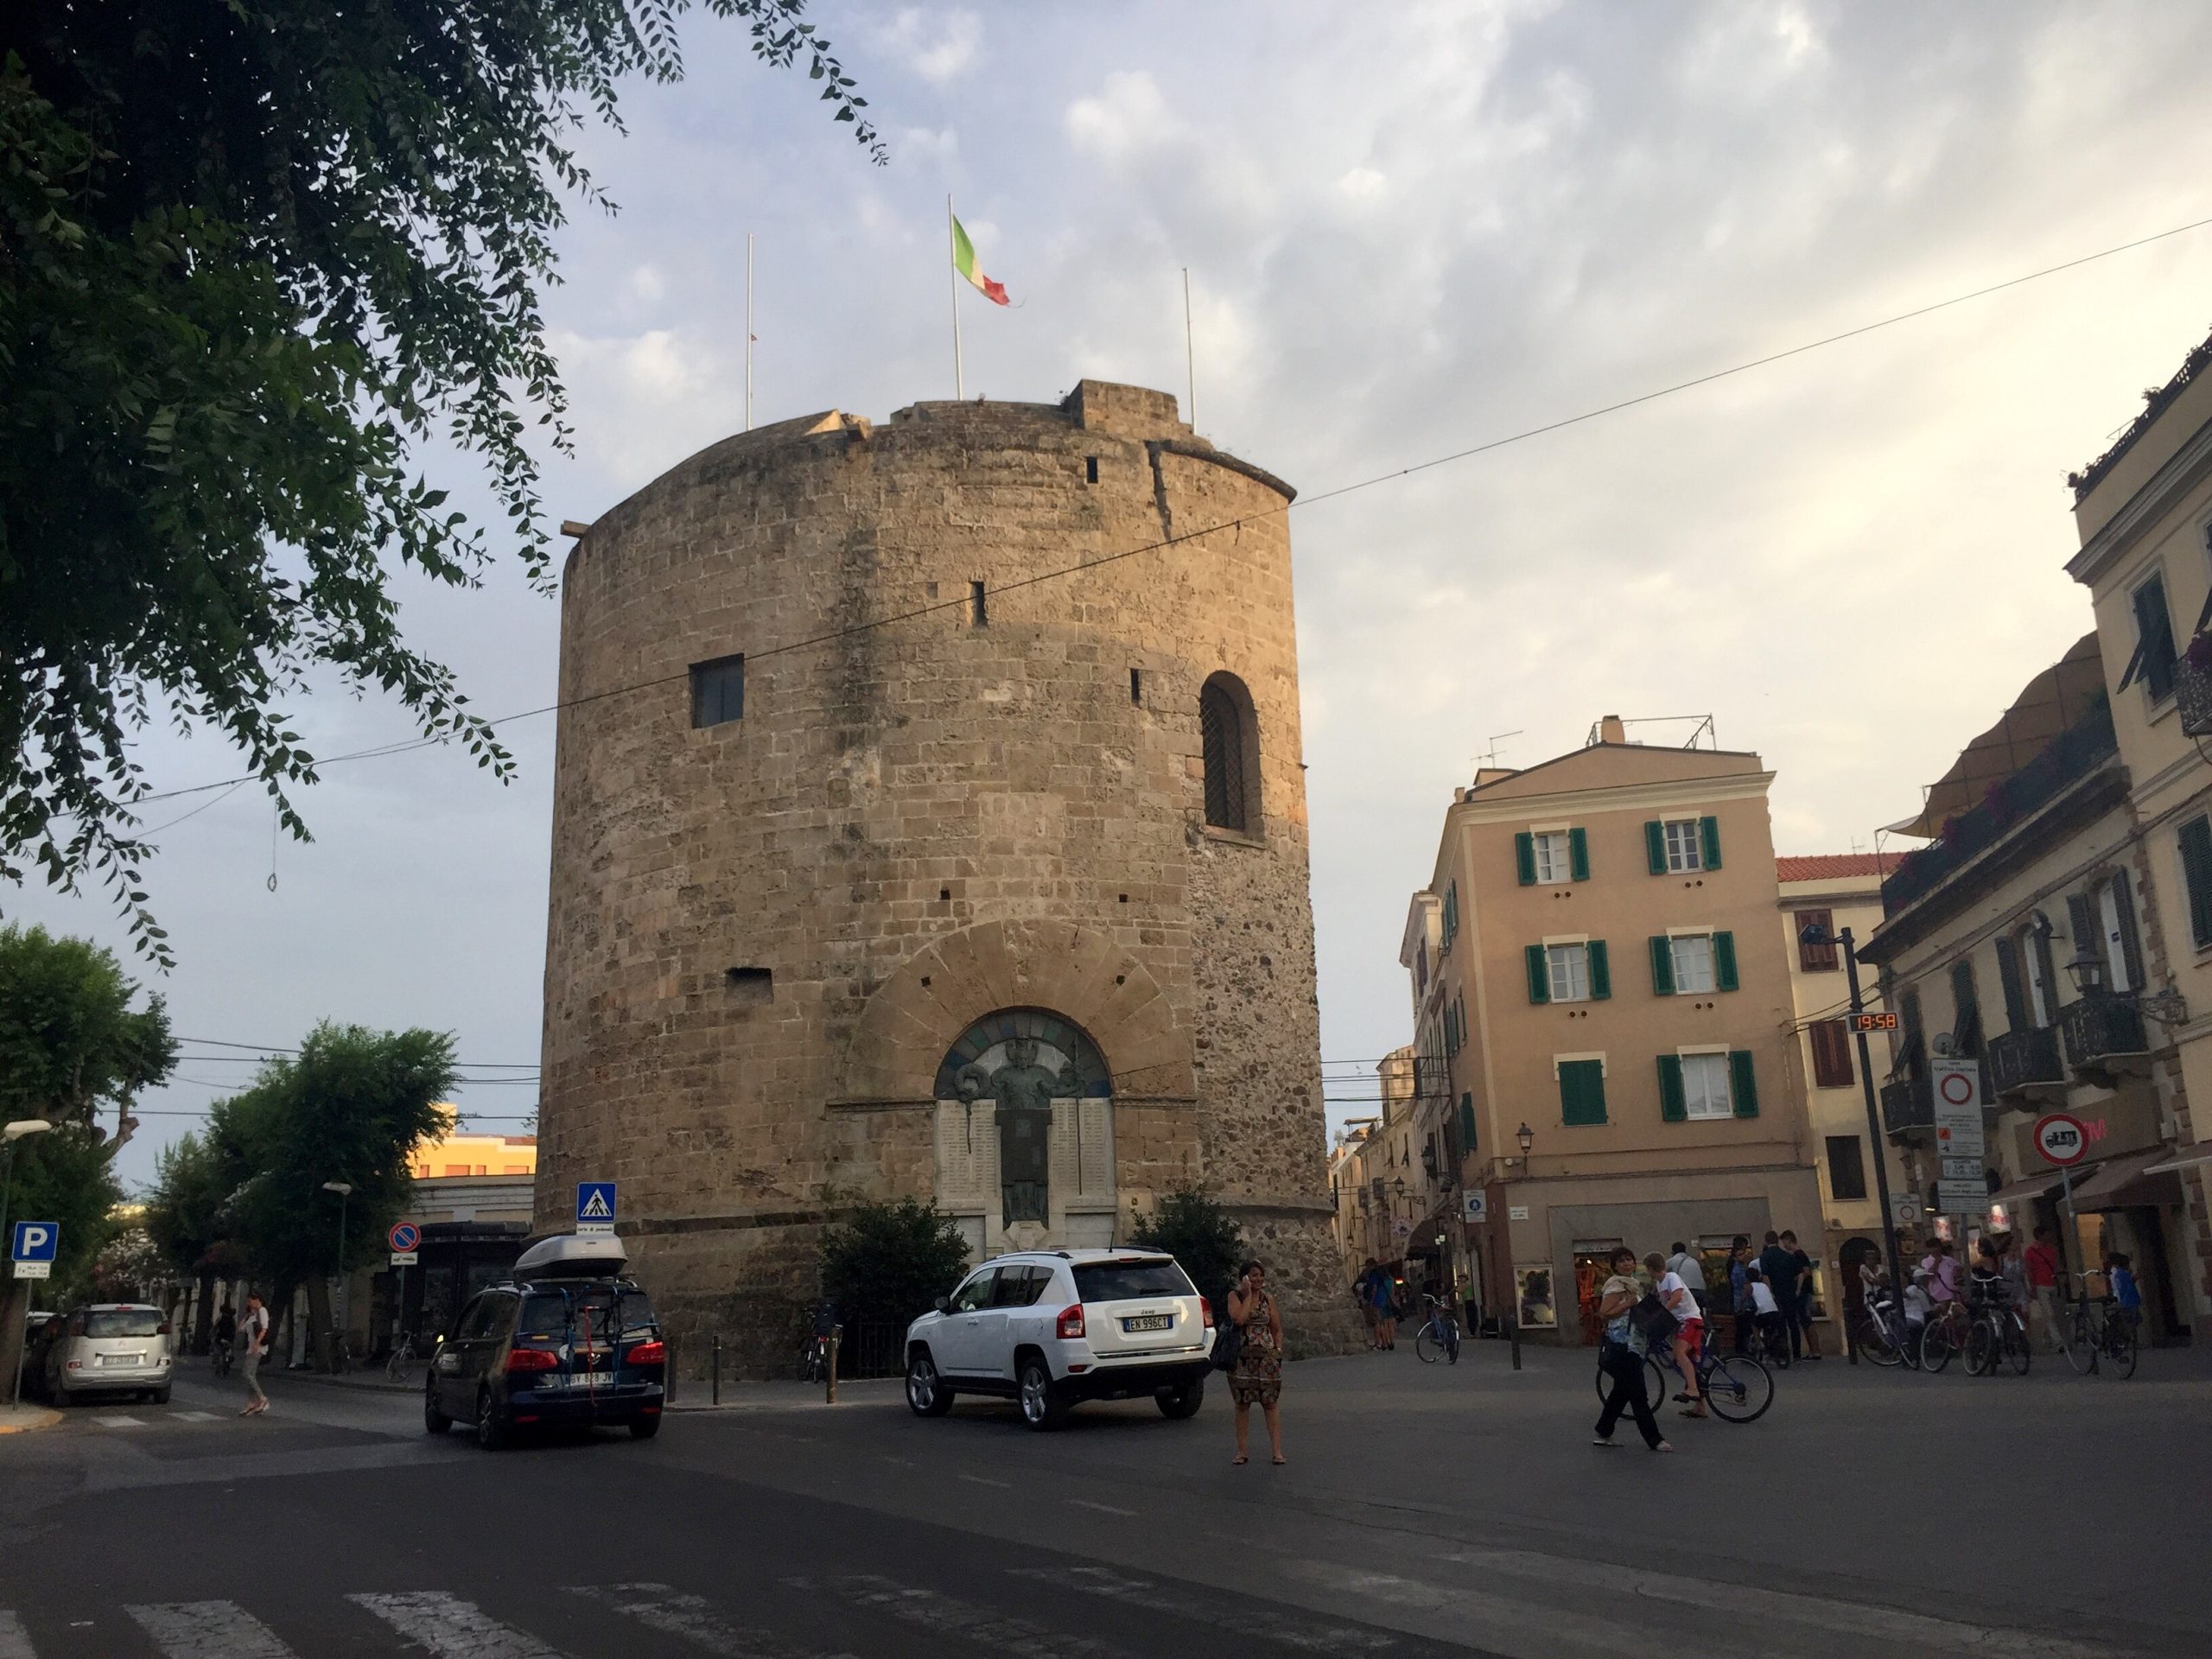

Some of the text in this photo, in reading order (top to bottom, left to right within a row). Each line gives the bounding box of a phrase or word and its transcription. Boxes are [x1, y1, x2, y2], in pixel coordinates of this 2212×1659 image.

[1858, 1014, 1896, 1030] 19:58
[22, 1227, 48, 1256] P
[1130, 1319, 1141, 1330] EN
